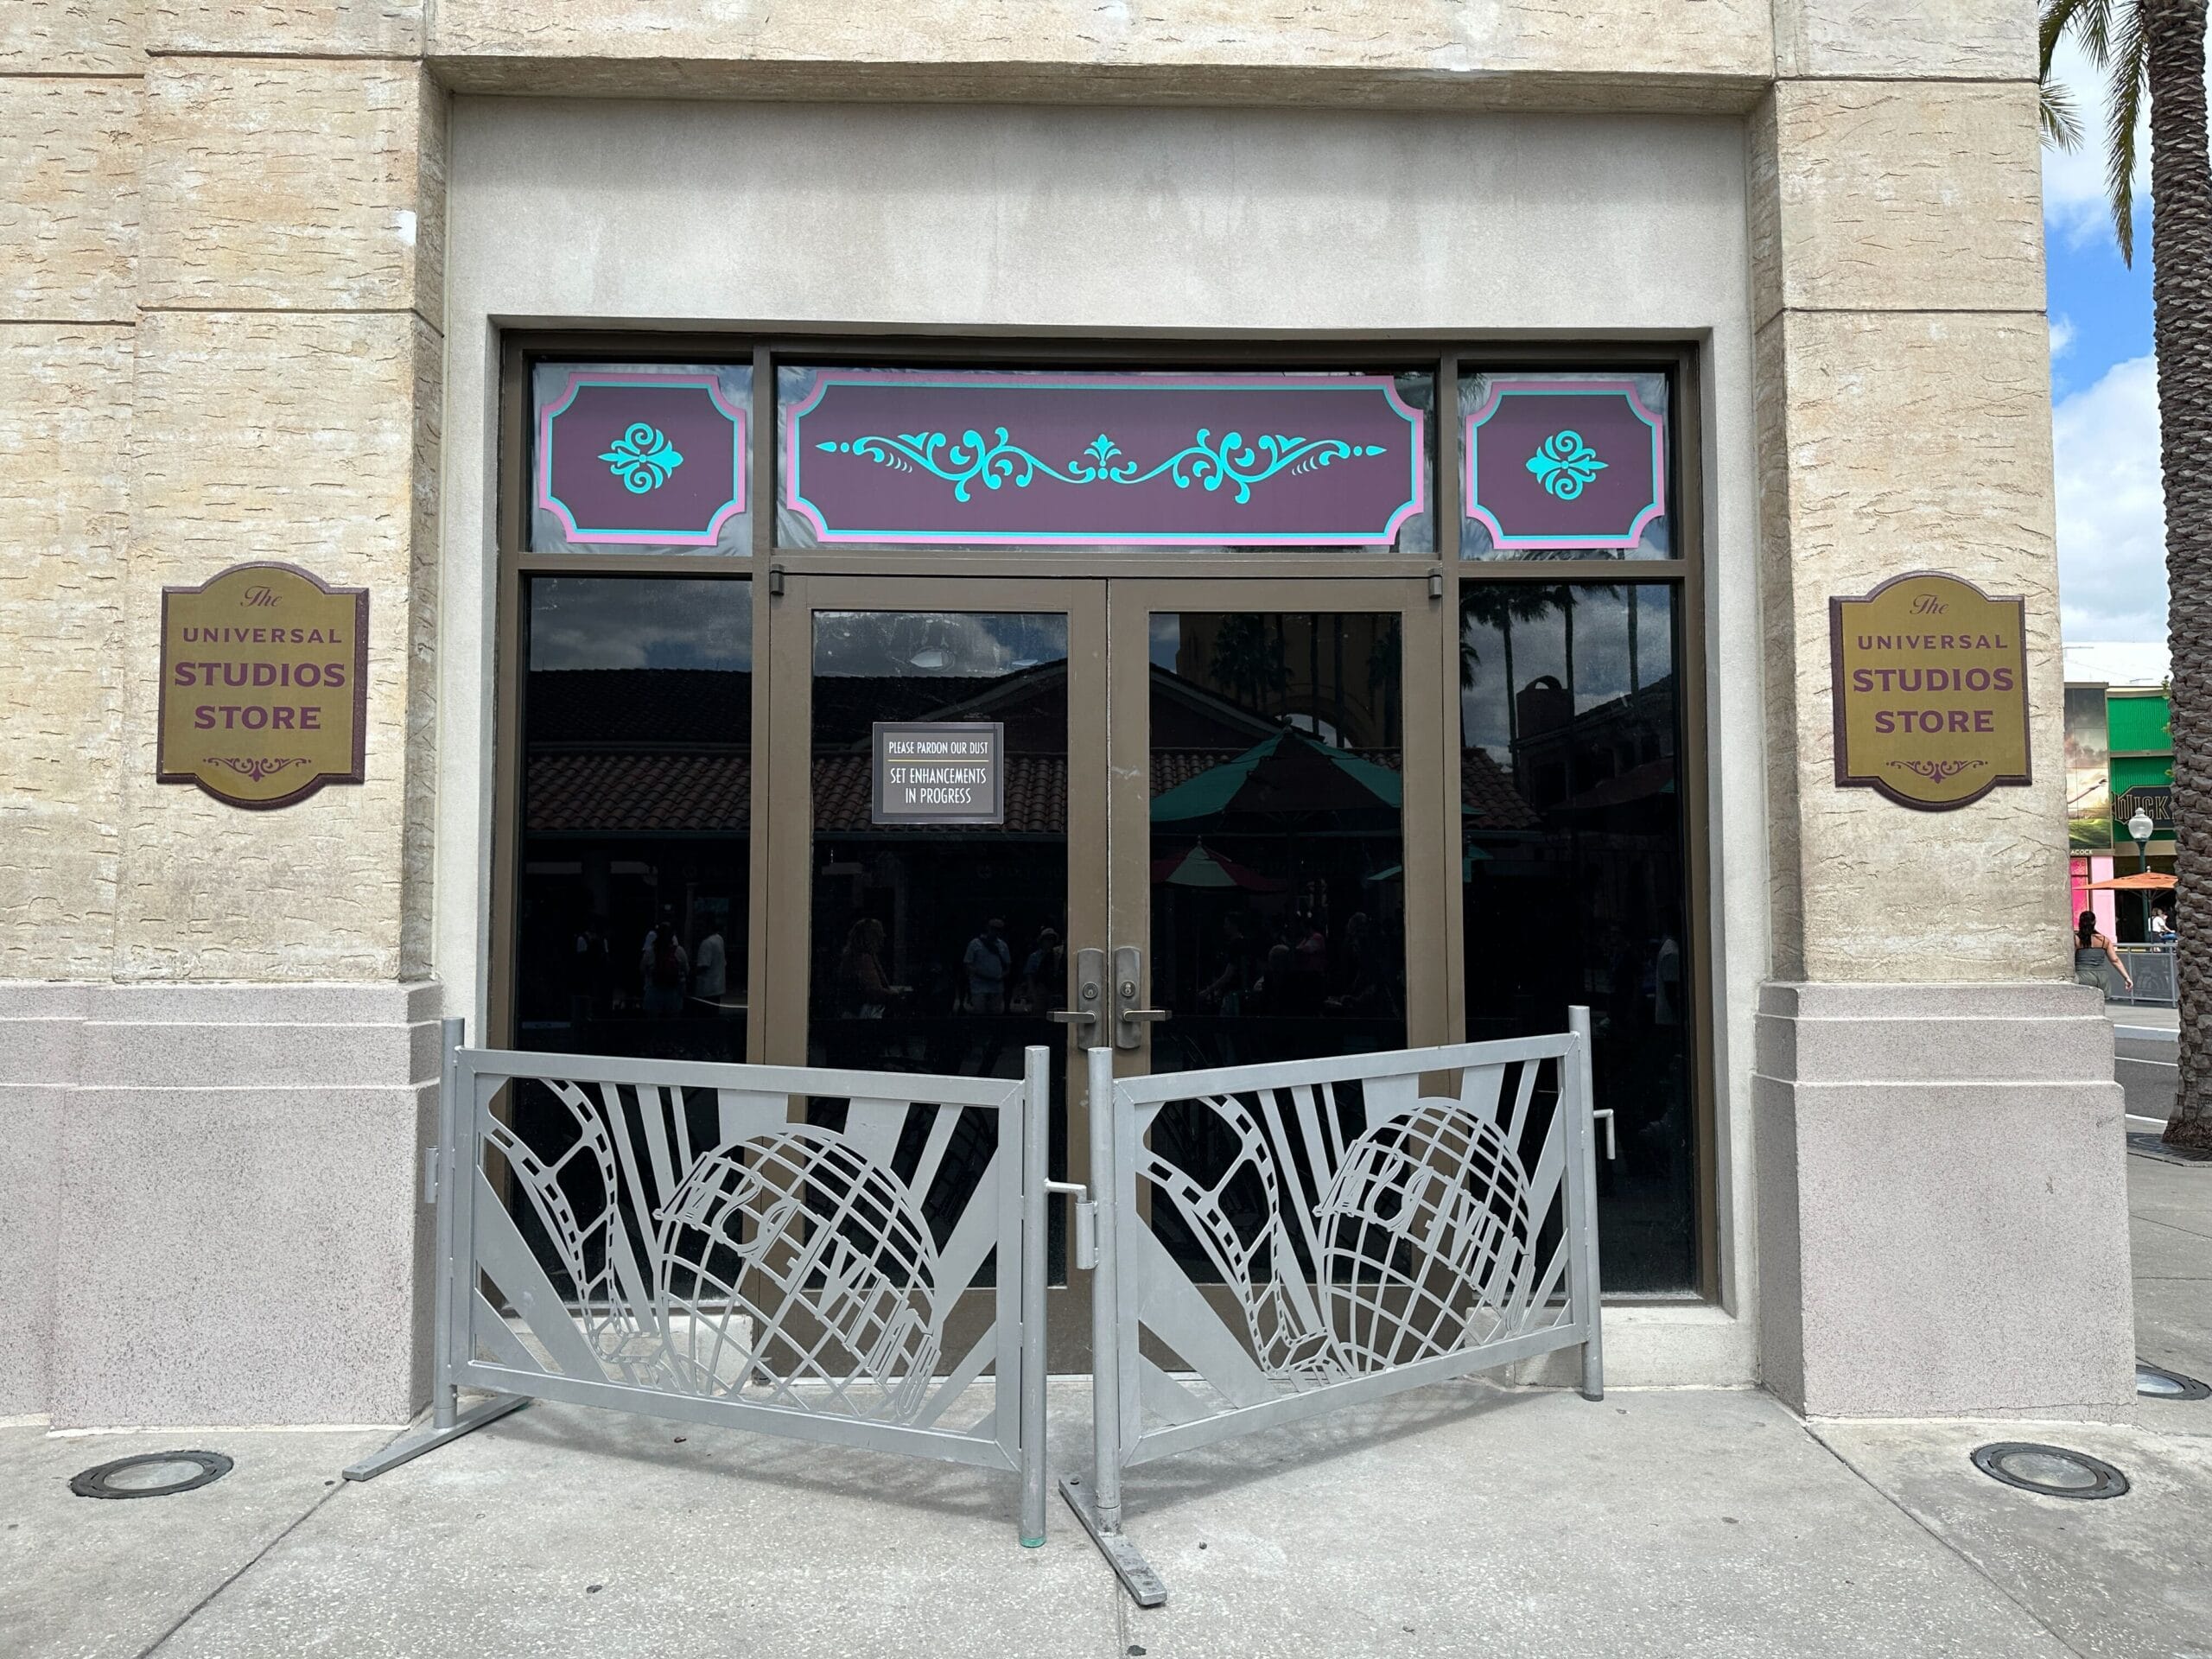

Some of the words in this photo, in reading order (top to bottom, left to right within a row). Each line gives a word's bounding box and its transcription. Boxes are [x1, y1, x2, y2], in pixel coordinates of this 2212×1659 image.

[239, 585, 283, 607] The
[1909, 594, 1949, 615] The
[182, 627, 342, 644] UNIVERSAL
[1858, 634, 2008, 650] UNIVERSAL
[175, 662, 346, 688] STUDIOS
[1853, 668, 2014, 692] STUDIOS
[194, 705, 321, 729] STORE
[1875, 710, 1994, 734] STORE
[888, 741, 915, 754] PLEASE
[917, 741, 948, 754] PARDON
[950, 741, 967, 754] OUR
[969, 741, 988, 754] DUST
[890, 767, 906, 784] SET
[910, 767, 987, 784] ENHANCEMENTS
[906, 788, 916, 804] IN
[920, 788, 971, 804] PROGRESS
[2114, 793, 2175, 825] WICK
